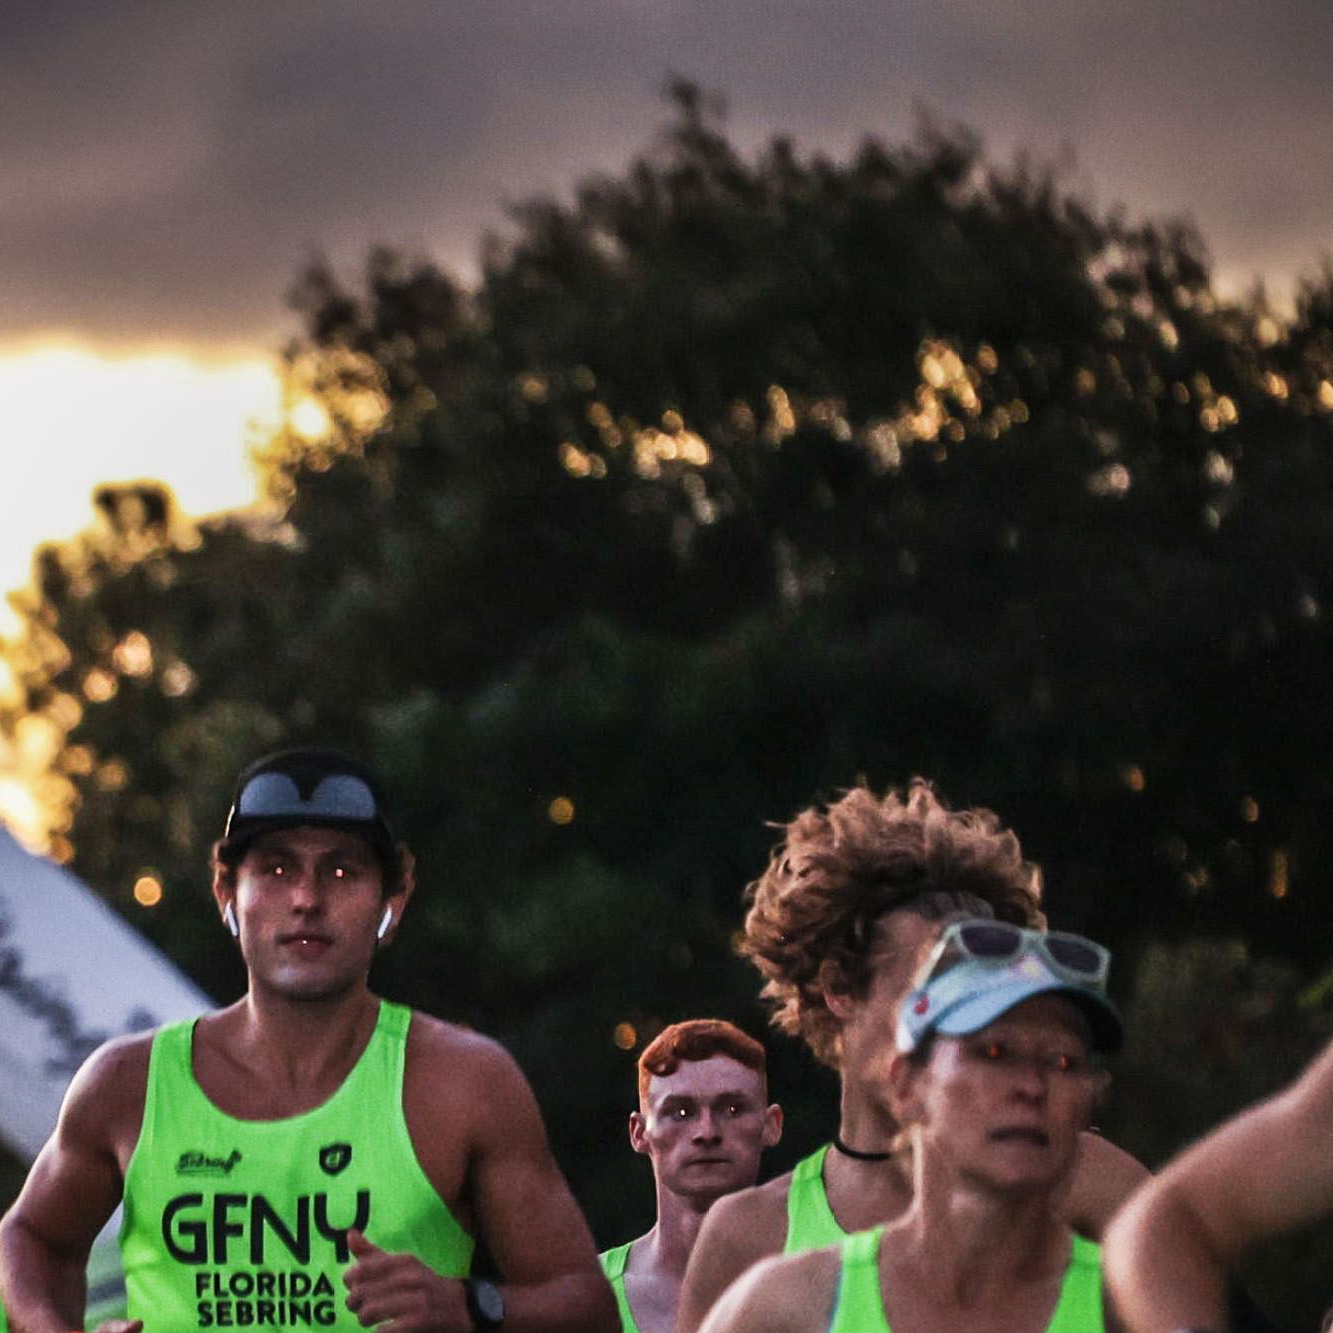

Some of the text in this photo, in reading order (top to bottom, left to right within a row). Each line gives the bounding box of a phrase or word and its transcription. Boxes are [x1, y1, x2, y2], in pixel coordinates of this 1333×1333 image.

[162, 1189, 370, 1266] GFNY
[195, 1272, 335, 1299] FLORIDA
[197, 1301, 336, 1328] SEBRING
